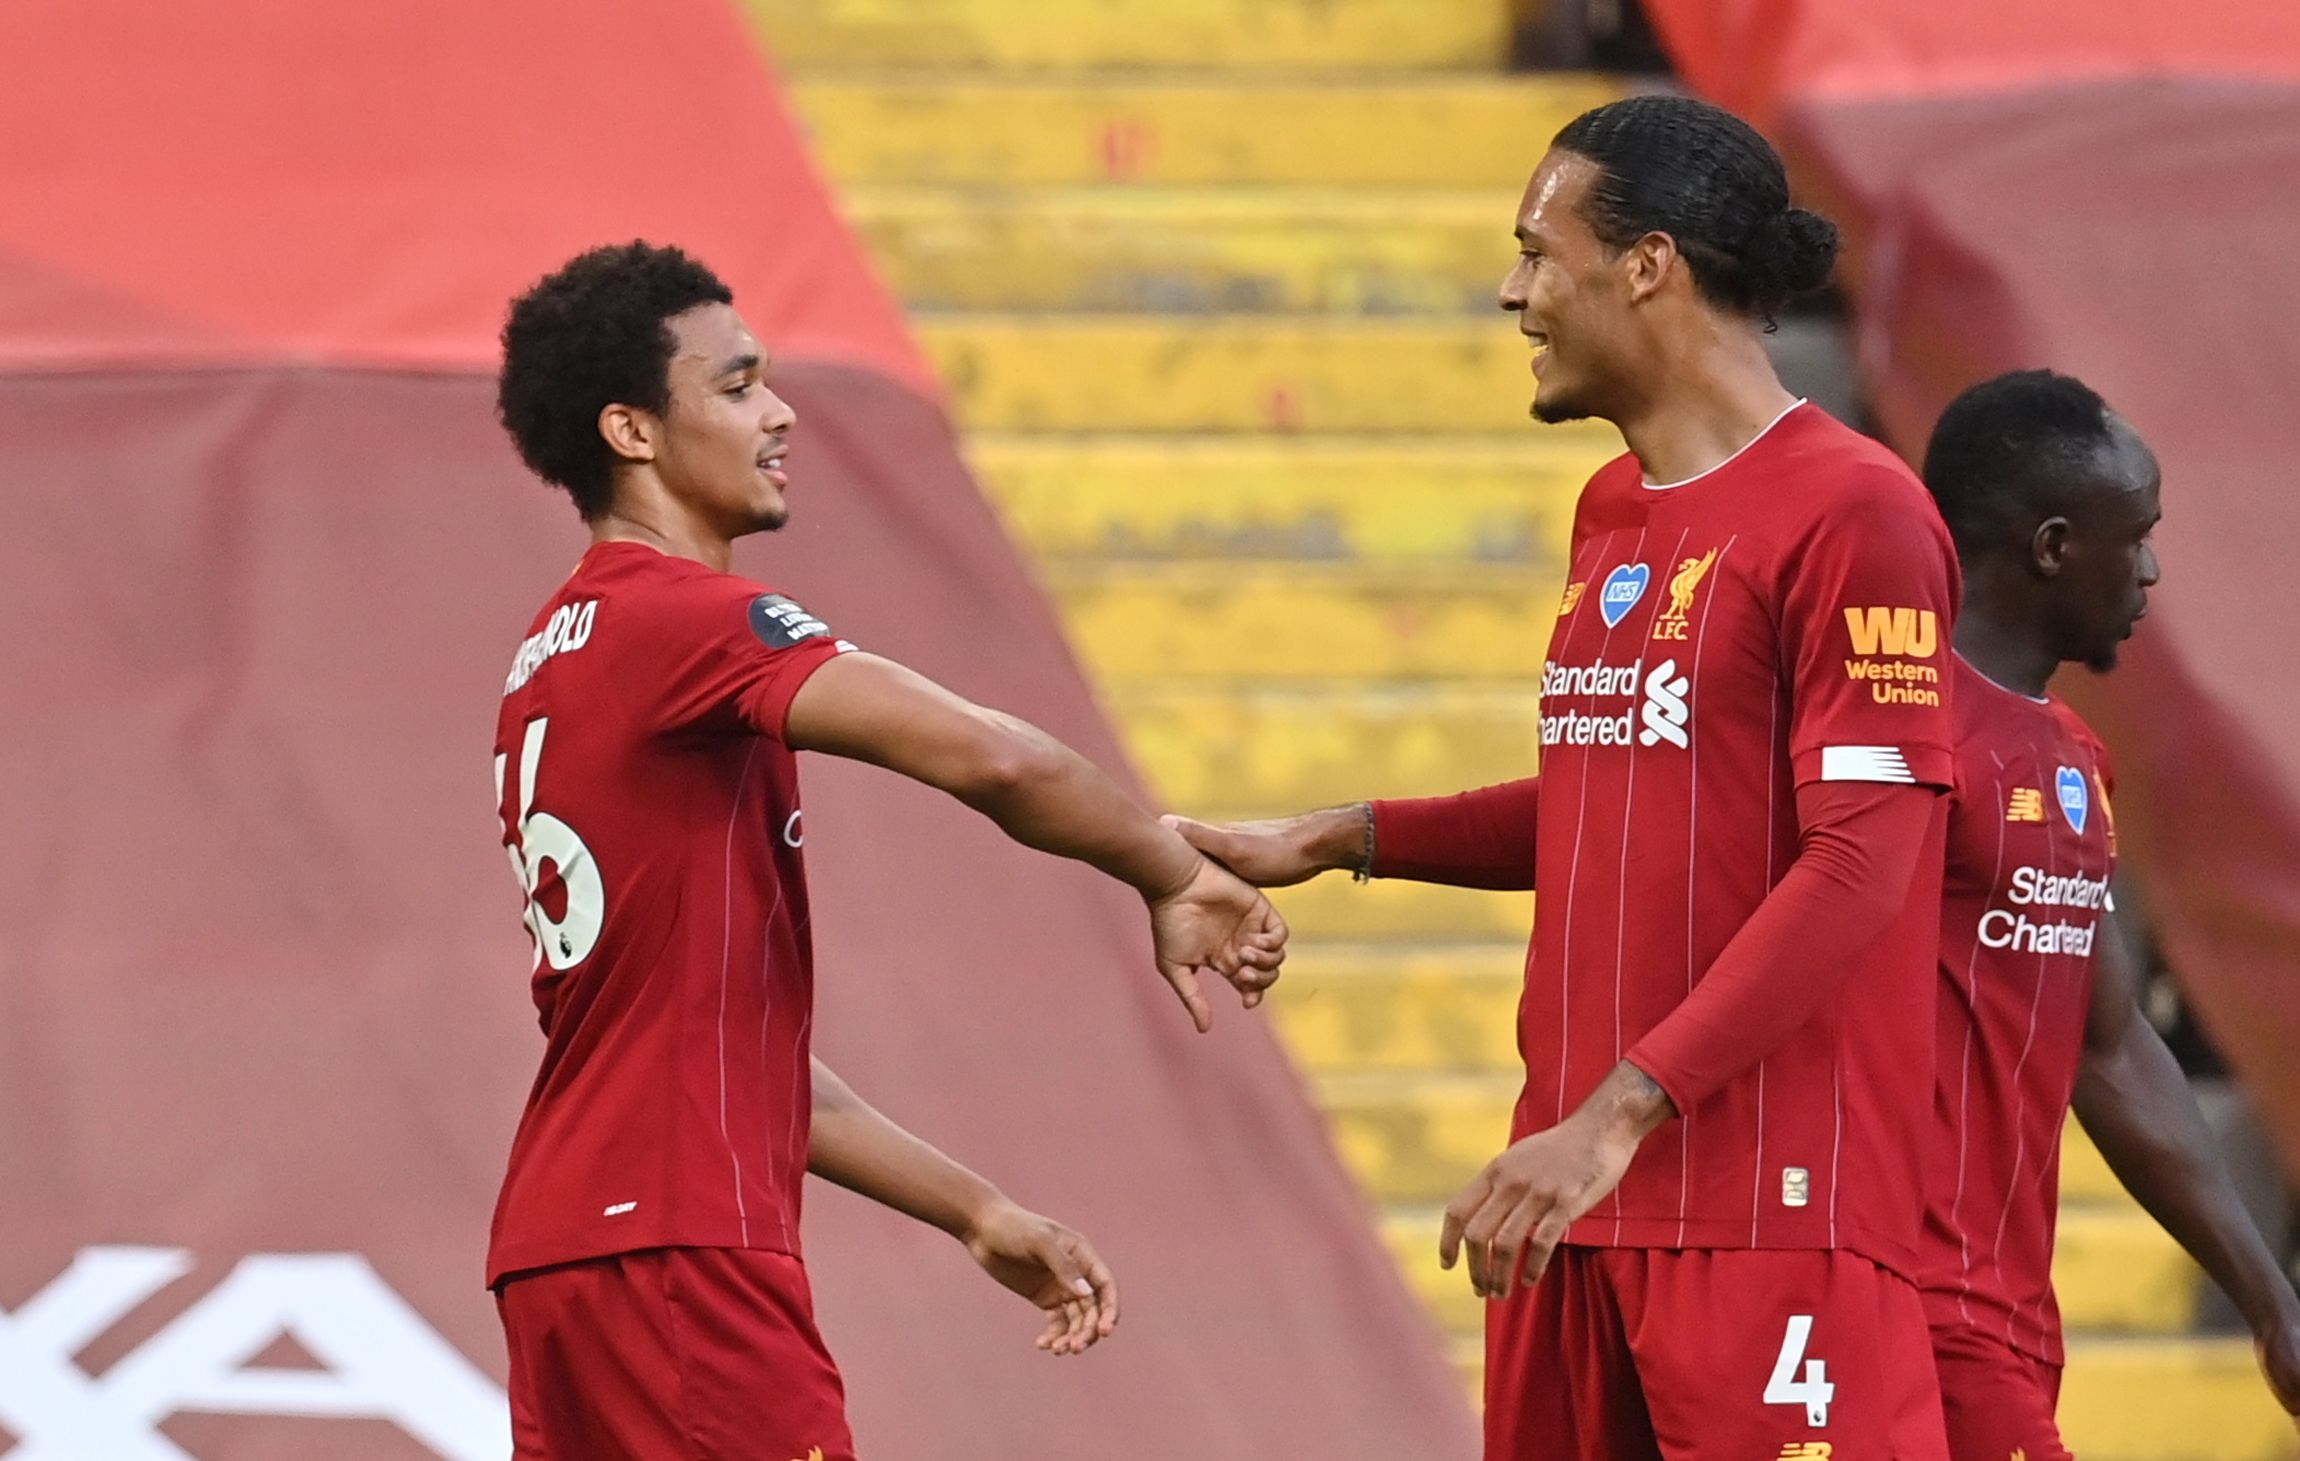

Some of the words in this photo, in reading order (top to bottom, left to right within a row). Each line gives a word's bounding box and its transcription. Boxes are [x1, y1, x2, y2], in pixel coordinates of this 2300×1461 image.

[1607, 583, 1637, 600] NHS
[1843, 606, 1937, 658] WU
[1539, 657, 1642, 698] Standard
[1844, 658, 1938, 683] Western
[1872, 681, 1939, 707] Union
[1539, 706, 1634, 746] hartered
[495, 717, 604, 971] 6
[2008, 866, 2108, 910] Standard
[1763, 1315, 1835, 1427] 4
